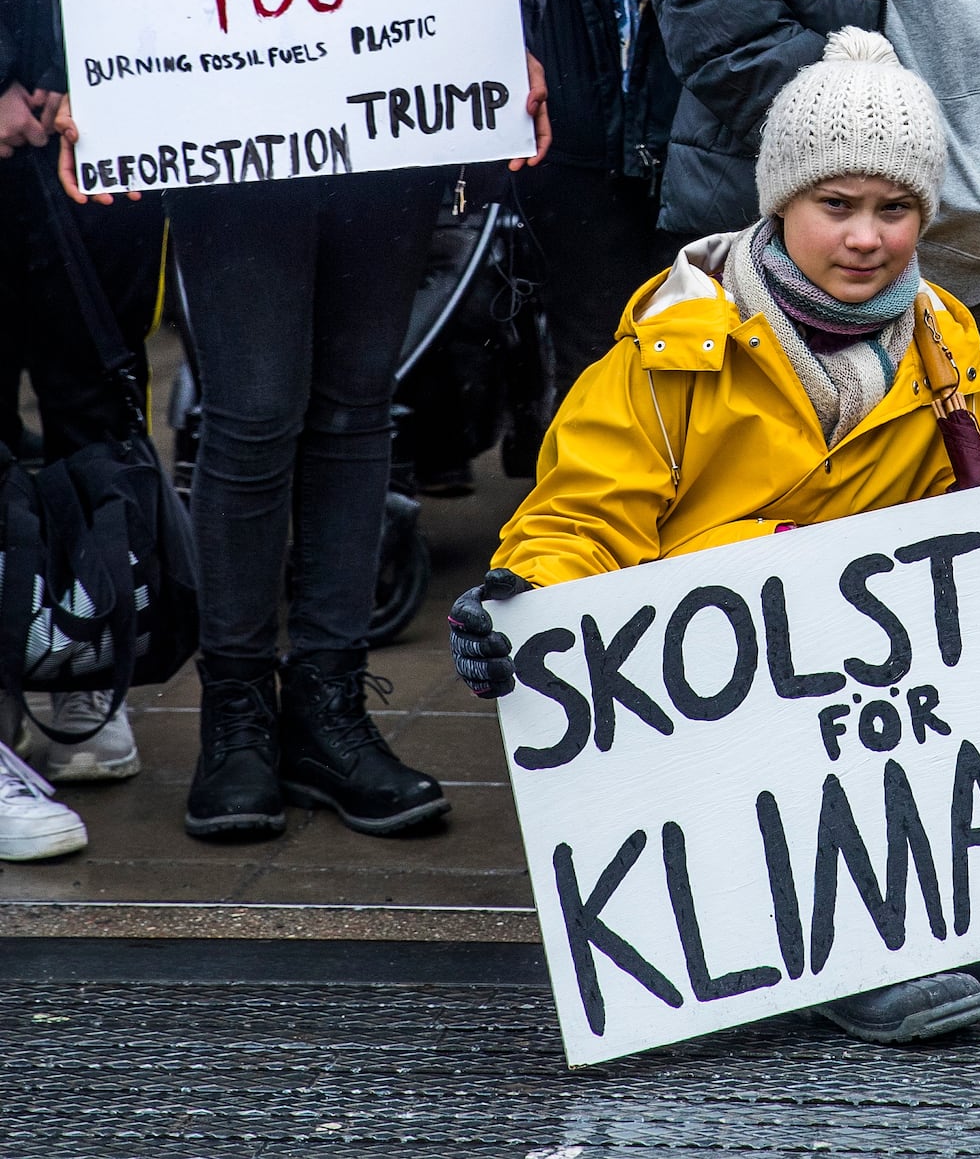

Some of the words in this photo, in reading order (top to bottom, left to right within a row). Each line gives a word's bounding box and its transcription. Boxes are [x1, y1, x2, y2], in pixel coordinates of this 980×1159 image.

[350, 15, 437, 55] PLASTIC
[85, 54, 193, 87] BURNING
[346, 80, 509, 140] TRUMP
[81, 123, 353, 191] DEFORESTATION
[819, 684, 951, 761] FÖR
